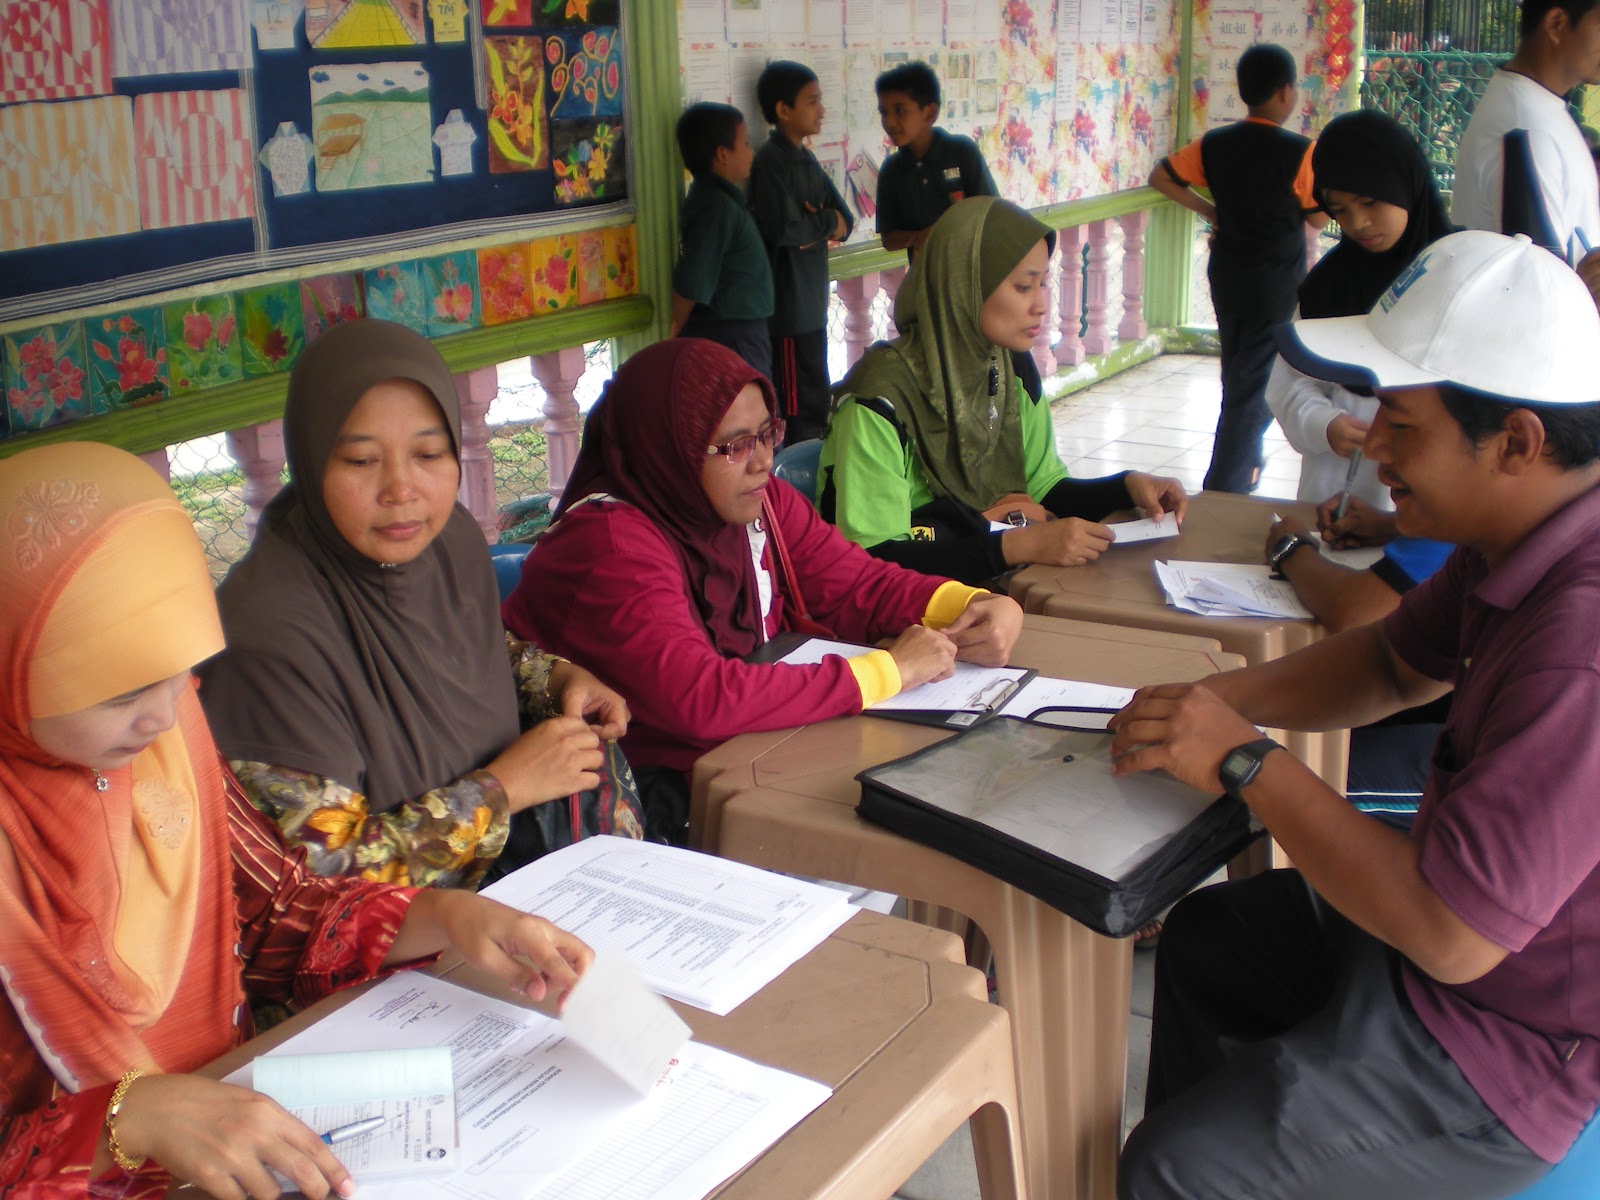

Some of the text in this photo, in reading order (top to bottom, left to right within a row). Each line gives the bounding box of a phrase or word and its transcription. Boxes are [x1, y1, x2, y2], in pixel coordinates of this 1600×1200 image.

[266, 4, 283, 25] 12
[437, 4, 455, 17] TM
[1219, 21, 1248, 35] 姐姐
[1271, 22, 1299, 37] 弟弟
